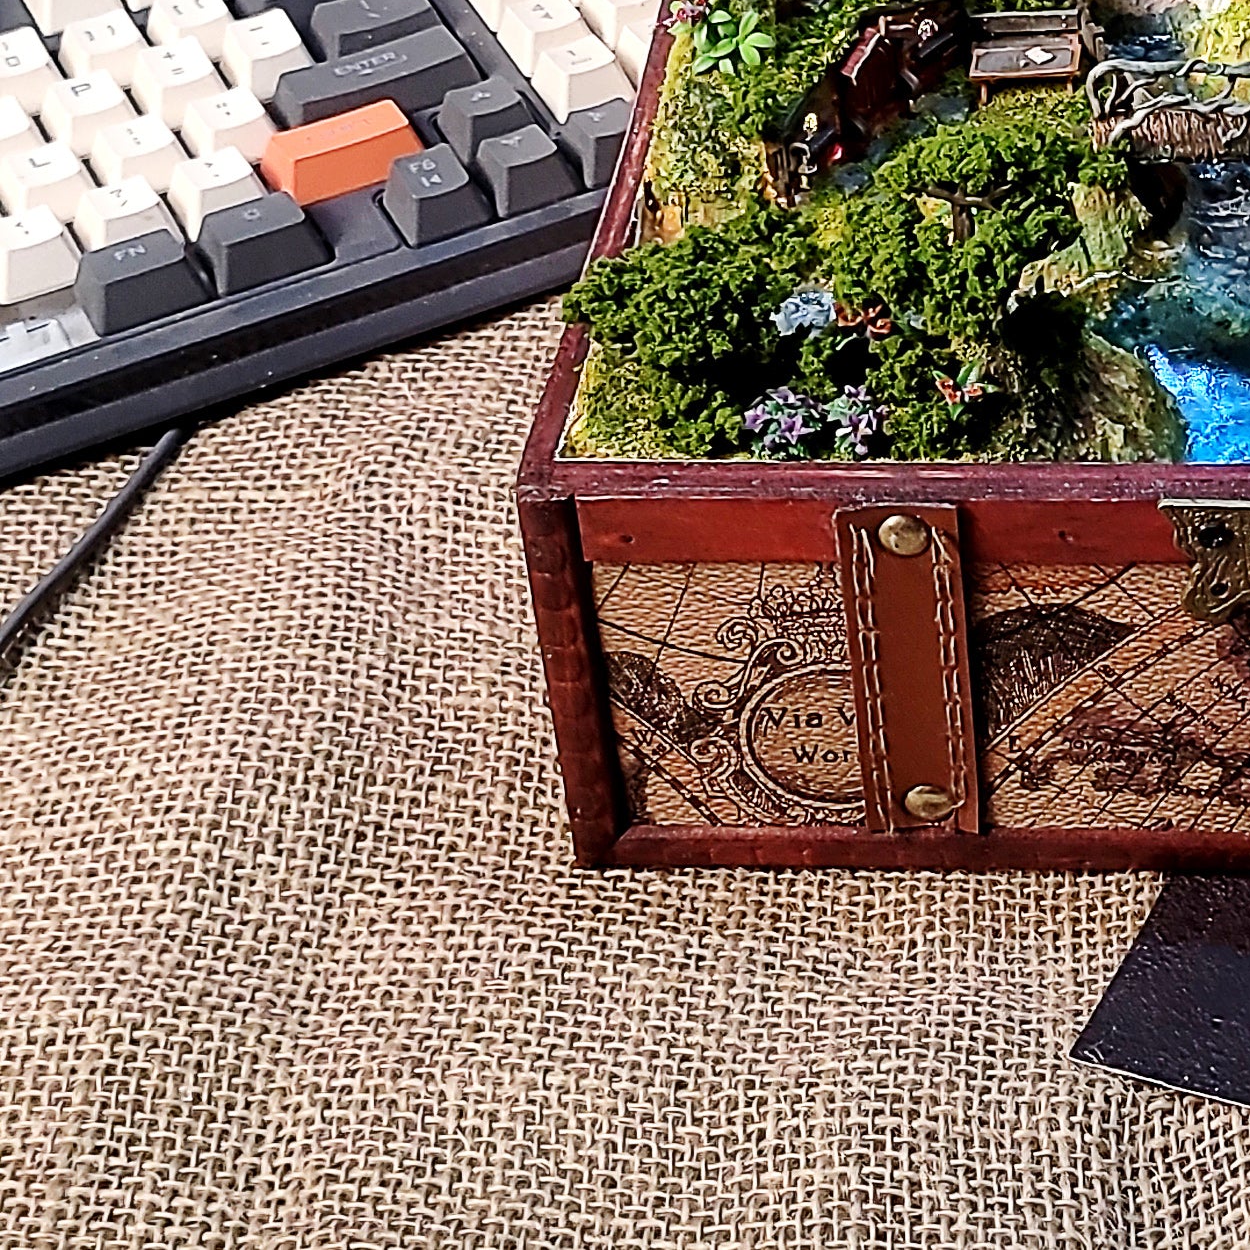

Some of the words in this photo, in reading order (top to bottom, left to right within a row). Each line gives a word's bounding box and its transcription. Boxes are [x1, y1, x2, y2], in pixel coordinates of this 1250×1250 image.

[333, 51, 396, 78] ENTER
[112, 244, 147, 262] FN
[791, 743, 854, 764] Wor
